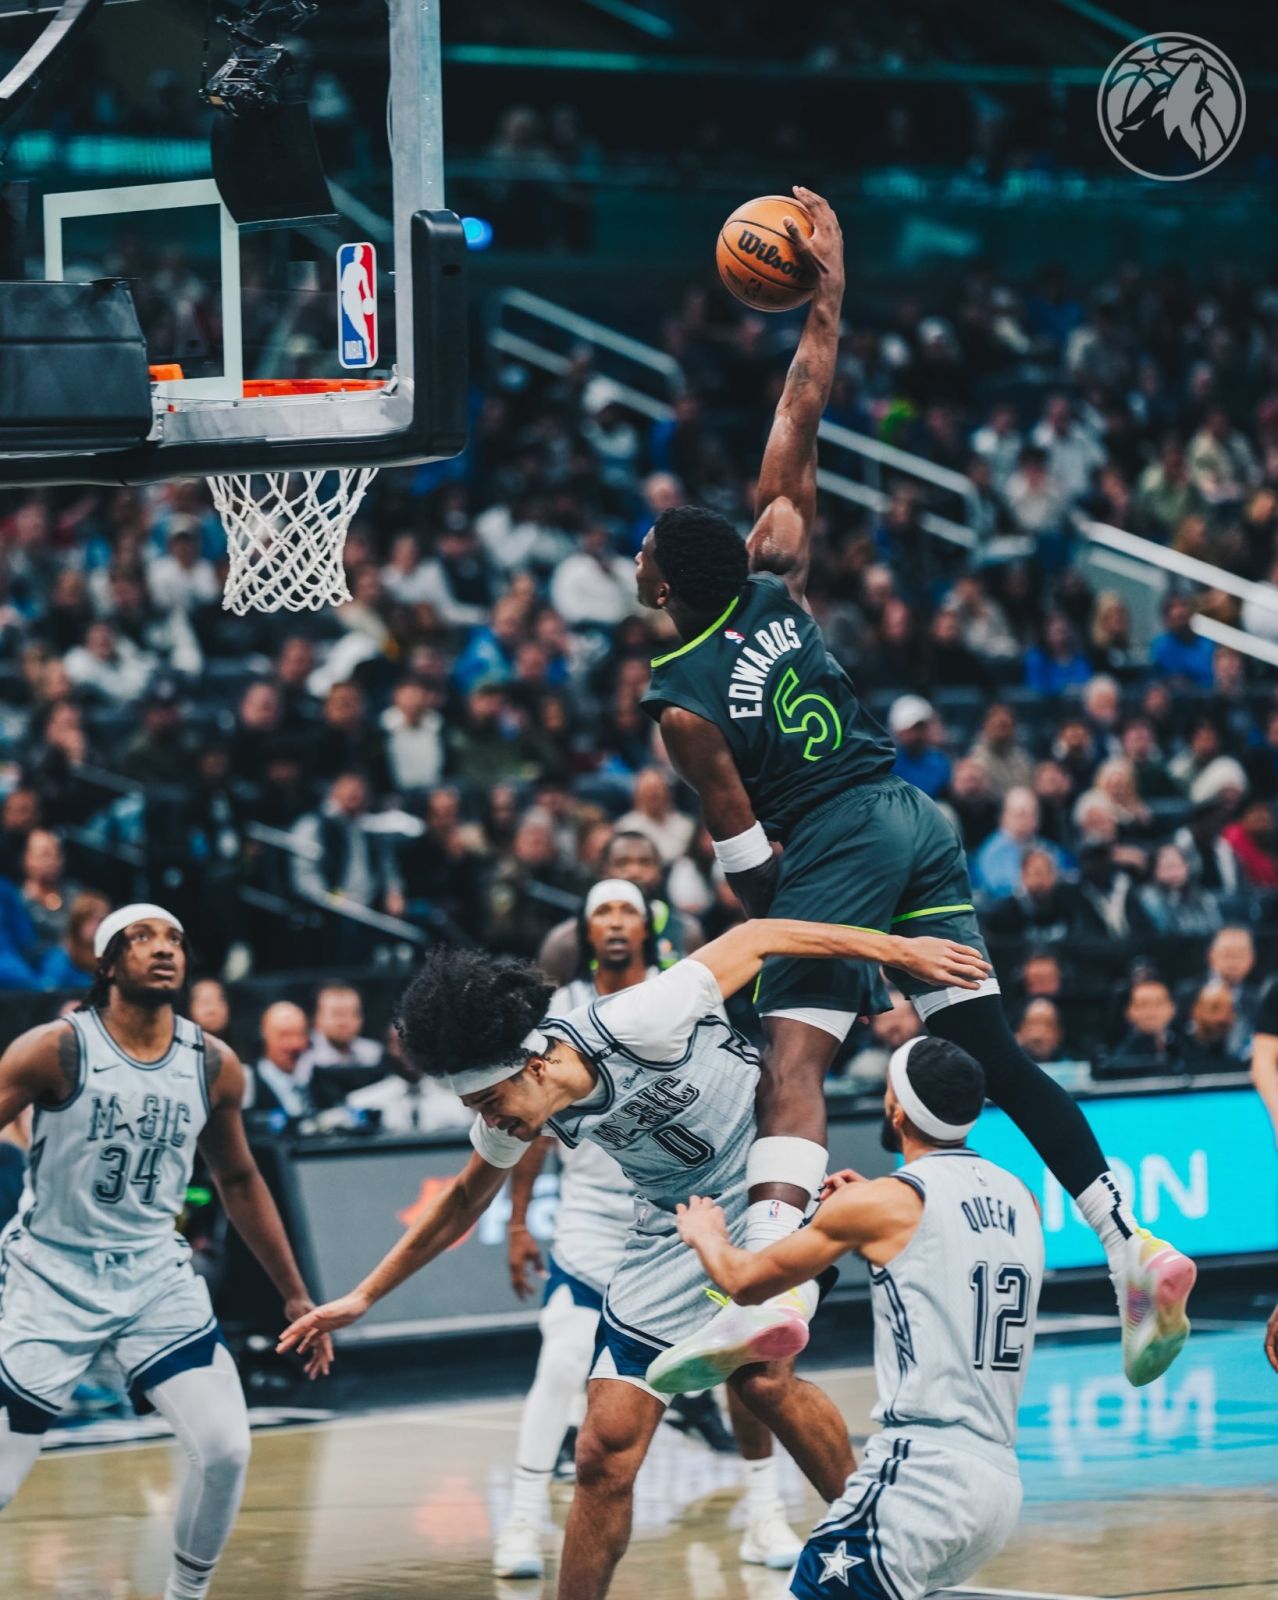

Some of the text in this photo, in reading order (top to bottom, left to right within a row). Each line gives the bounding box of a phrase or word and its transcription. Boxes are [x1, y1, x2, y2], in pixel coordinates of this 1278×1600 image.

[728, 617, 802, 719] EDWARDS
[773, 667, 842, 761] 5
[93, 1143, 167, 1205] 34
[648, 1123, 715, 1168] 0
[961, 1196, 1016, 1236] QUEEN
[970, 1260, 1031, 1372] 12
